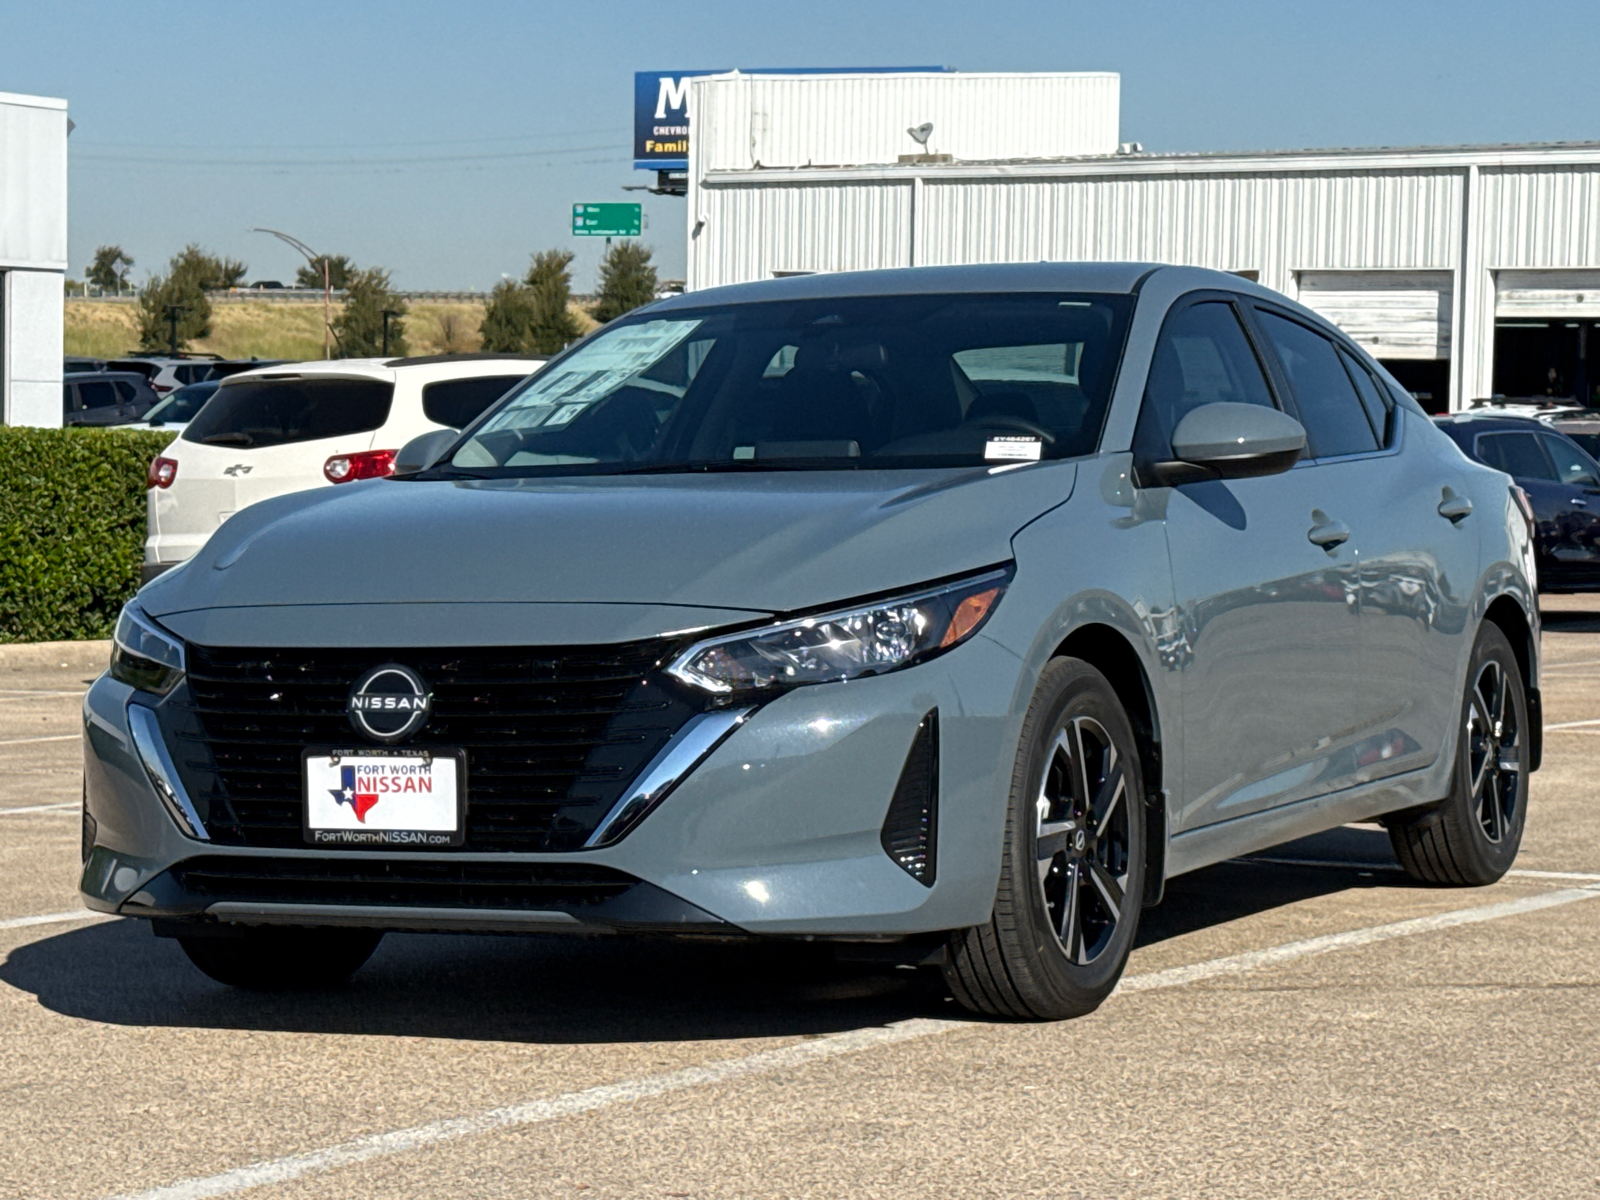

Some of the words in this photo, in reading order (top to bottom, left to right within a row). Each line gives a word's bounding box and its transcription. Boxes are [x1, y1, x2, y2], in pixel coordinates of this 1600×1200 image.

[351, 696, 427, 710] NISSAN
[357, 765, 386, 775] FORT
[389, 765, 432, 775] WORTH
[357, 776, 432, 794] NISSAN
